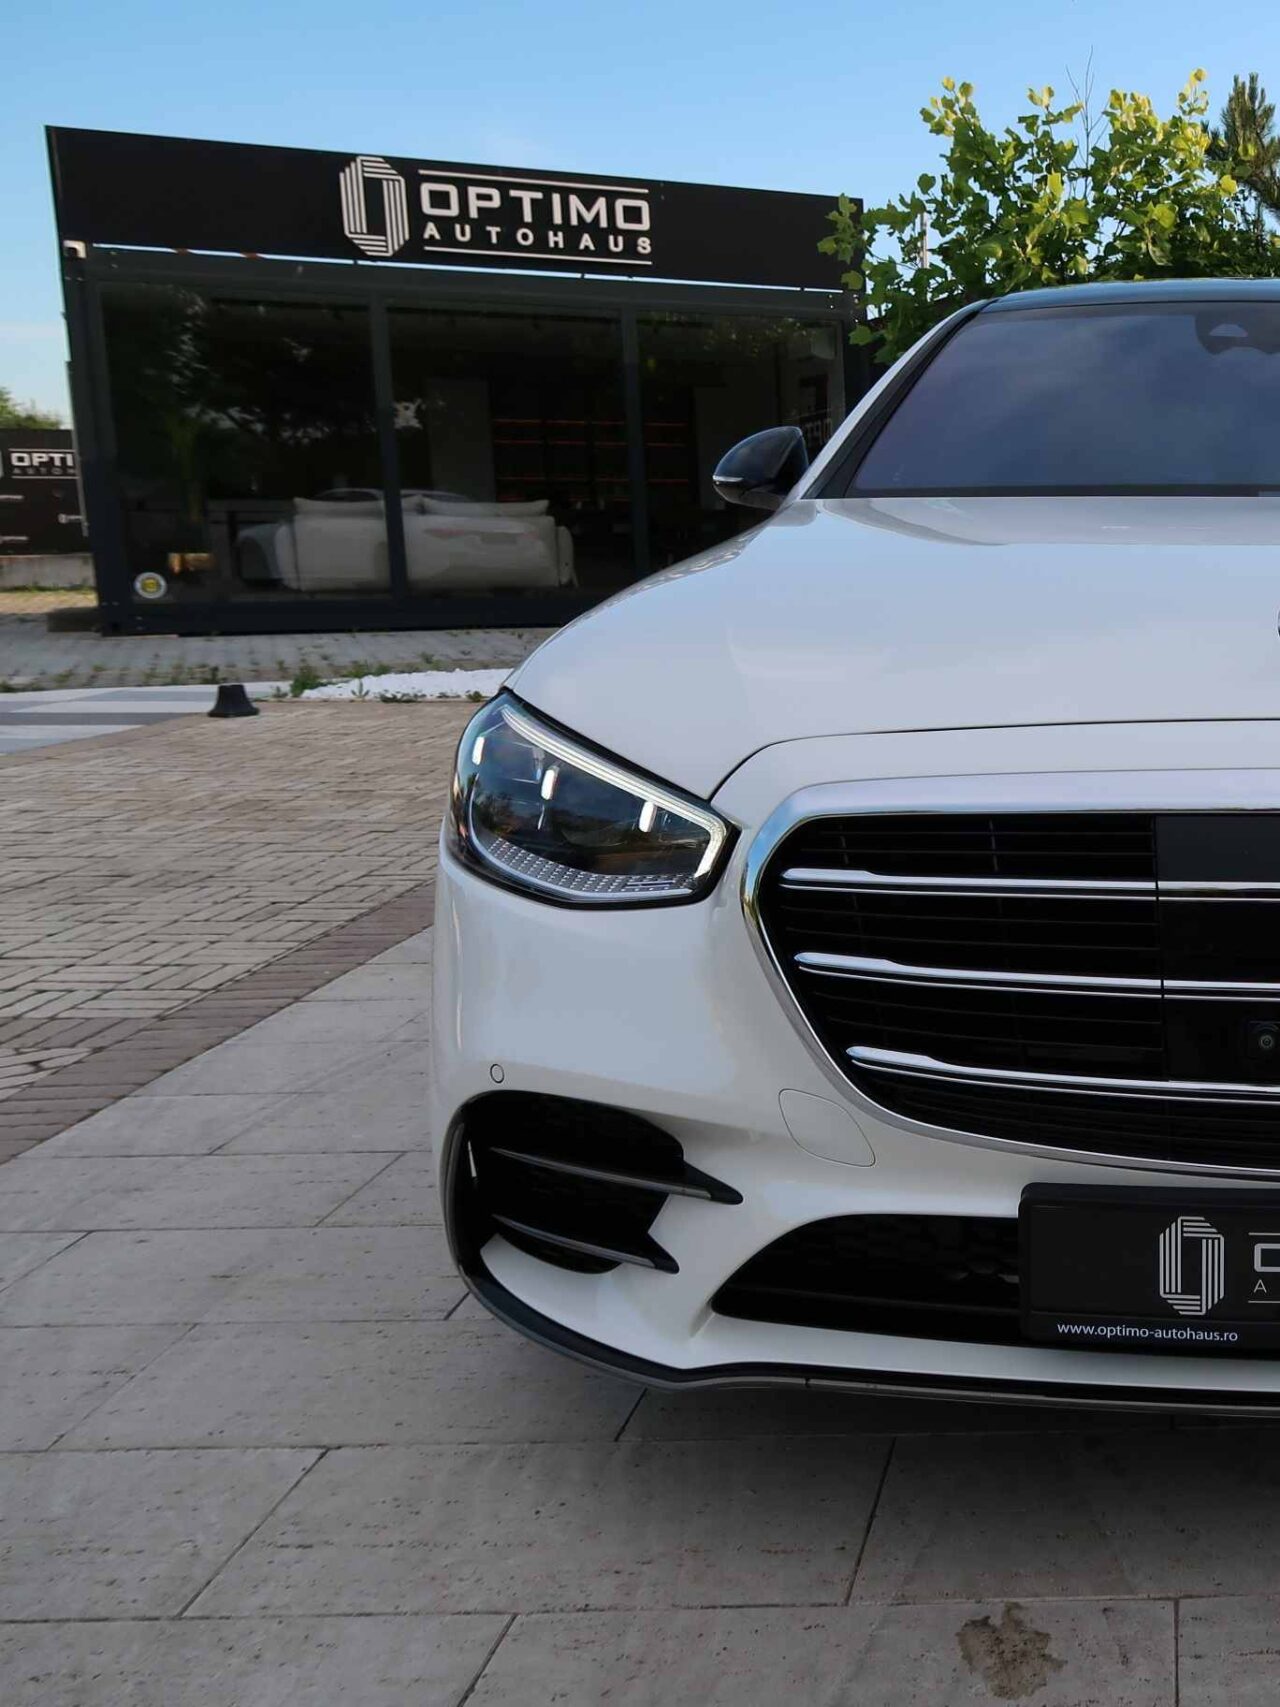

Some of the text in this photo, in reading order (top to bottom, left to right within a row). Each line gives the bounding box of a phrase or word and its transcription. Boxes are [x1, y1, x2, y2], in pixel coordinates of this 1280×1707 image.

[419, 182, 650, 231] OPTIMO
[423, 221, 652, 254] AUTOHAUS
[11, 453, 74, 466] OPTI
[1057, 1324, 1239, 1342] www.optimo-autohaus.ro
